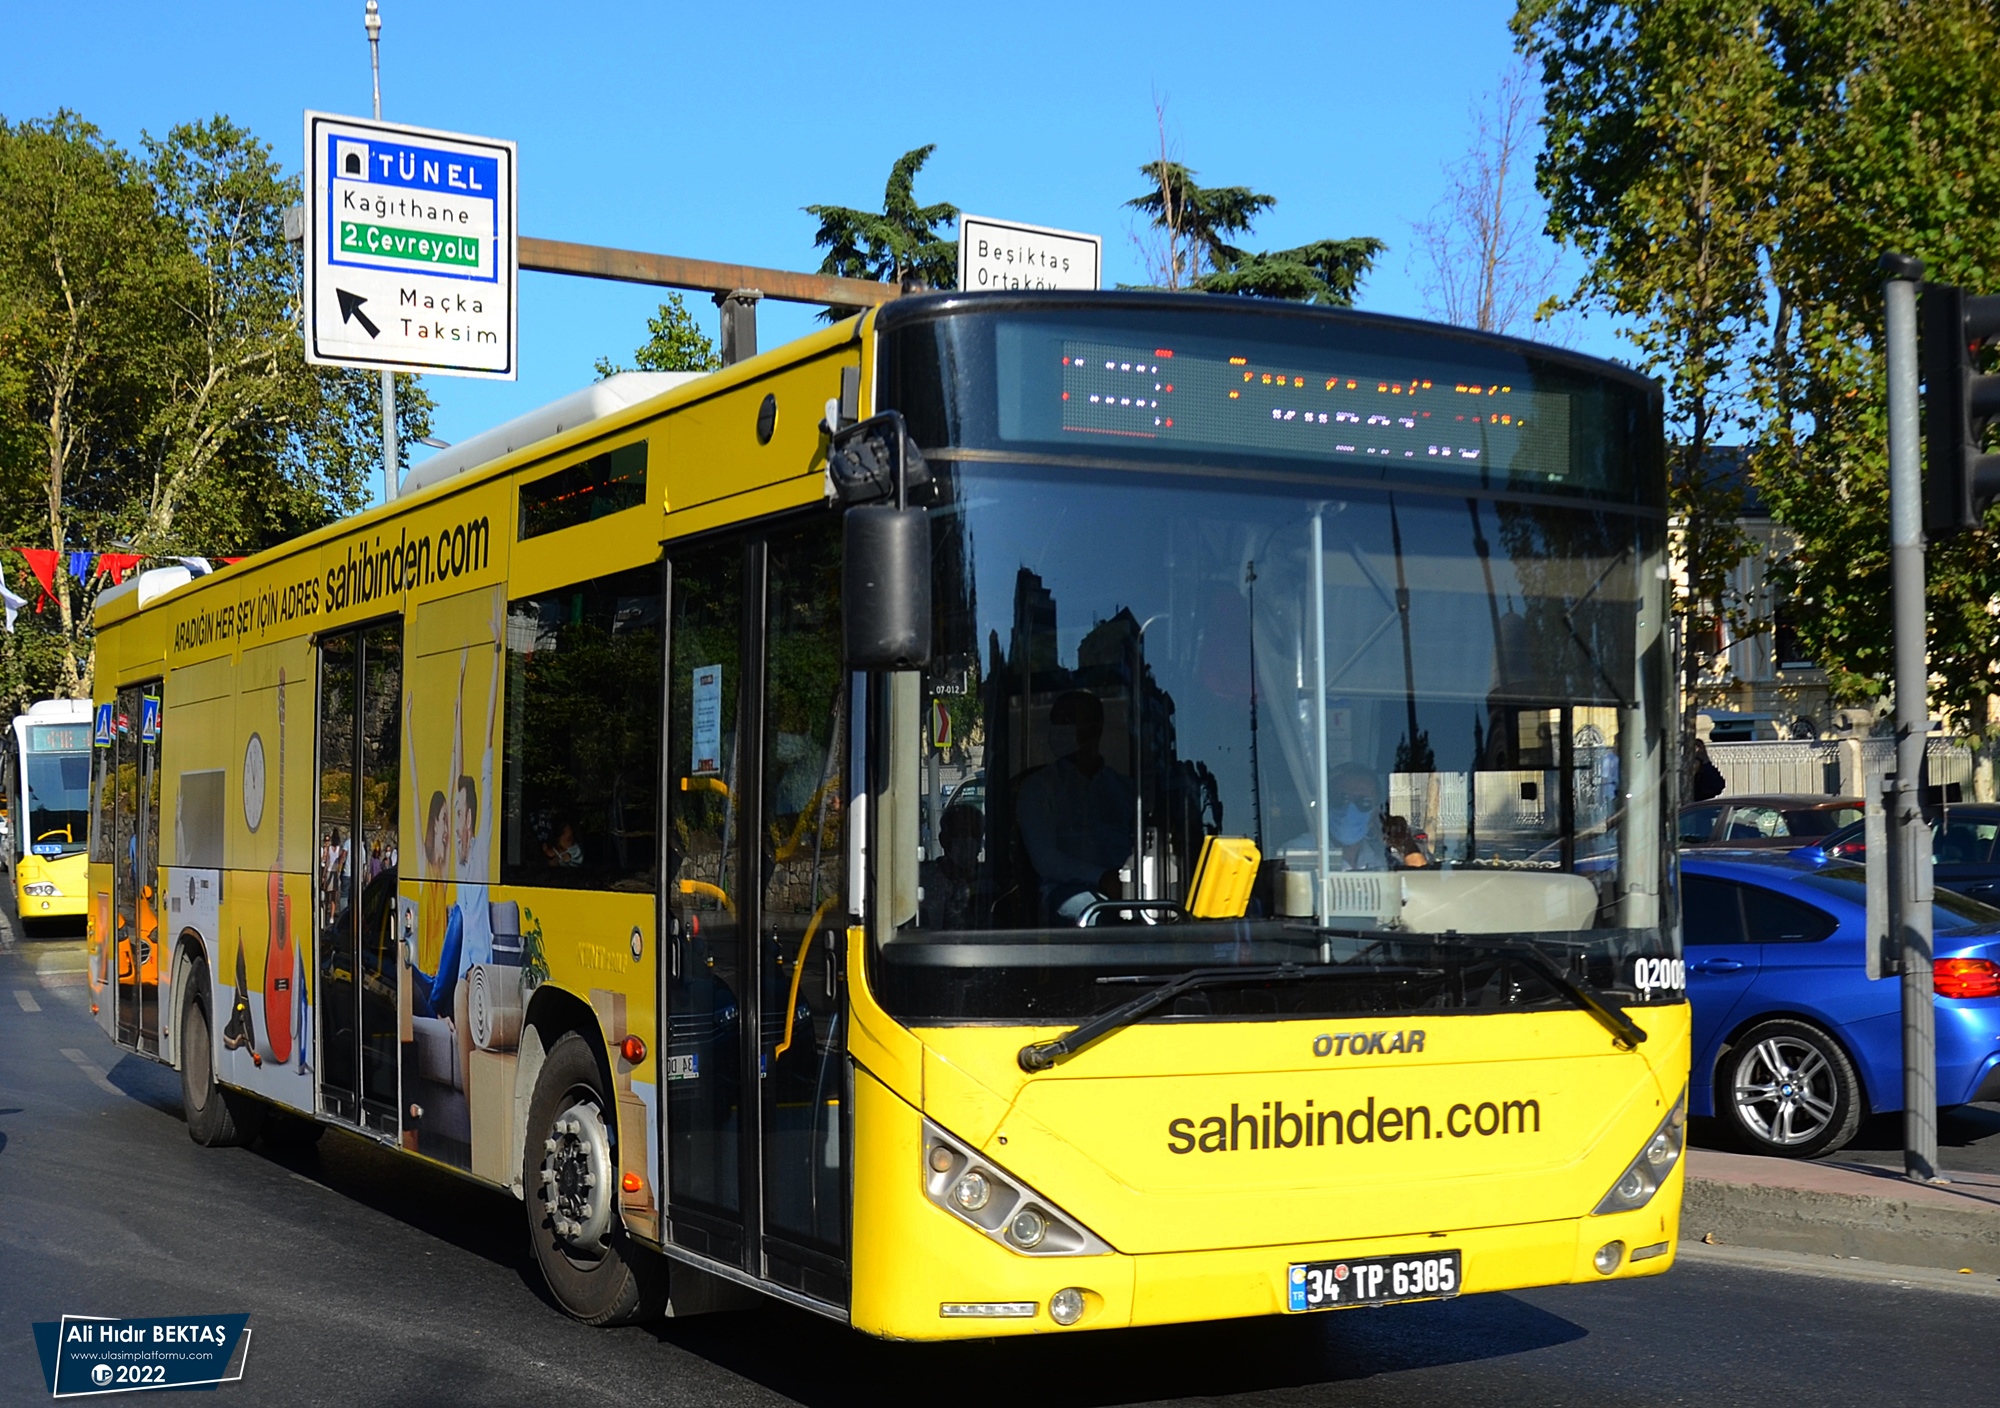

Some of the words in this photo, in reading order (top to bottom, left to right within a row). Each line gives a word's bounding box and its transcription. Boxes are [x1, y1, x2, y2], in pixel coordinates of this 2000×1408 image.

[379, 151, 482, 190] TÜNEL
[344, 190, 469, 224] Kağıthane
[979, 240, 1070, 273] Beşiktaş
[400, 288, 483, 313] Maçka
[400, 318, 497, 343] Taksim
[174, 608, 213, 653] ARADIĞIN
[215, 607, 235, 641] HER
[236, 597, 256, 644] ŞEY
[257, 584, 279, 637] İÇİN
[279, 577, 320, 622] ADRES
[325, 515, 490, 614] sahibinden.com
[935, 685, 960, 695] 07-012
[1312, 1029, 1426, 1057] OTOKAR
[1168, 1096, 1541, 1155] sahibinden.com
[1292, 1291, 1305, 1301] TR
[1307, 1268, 1340, 1303] 34
[1352, 1264, 1383, 1299] TP
[1393, 1258, 1455, 1295] 6385
